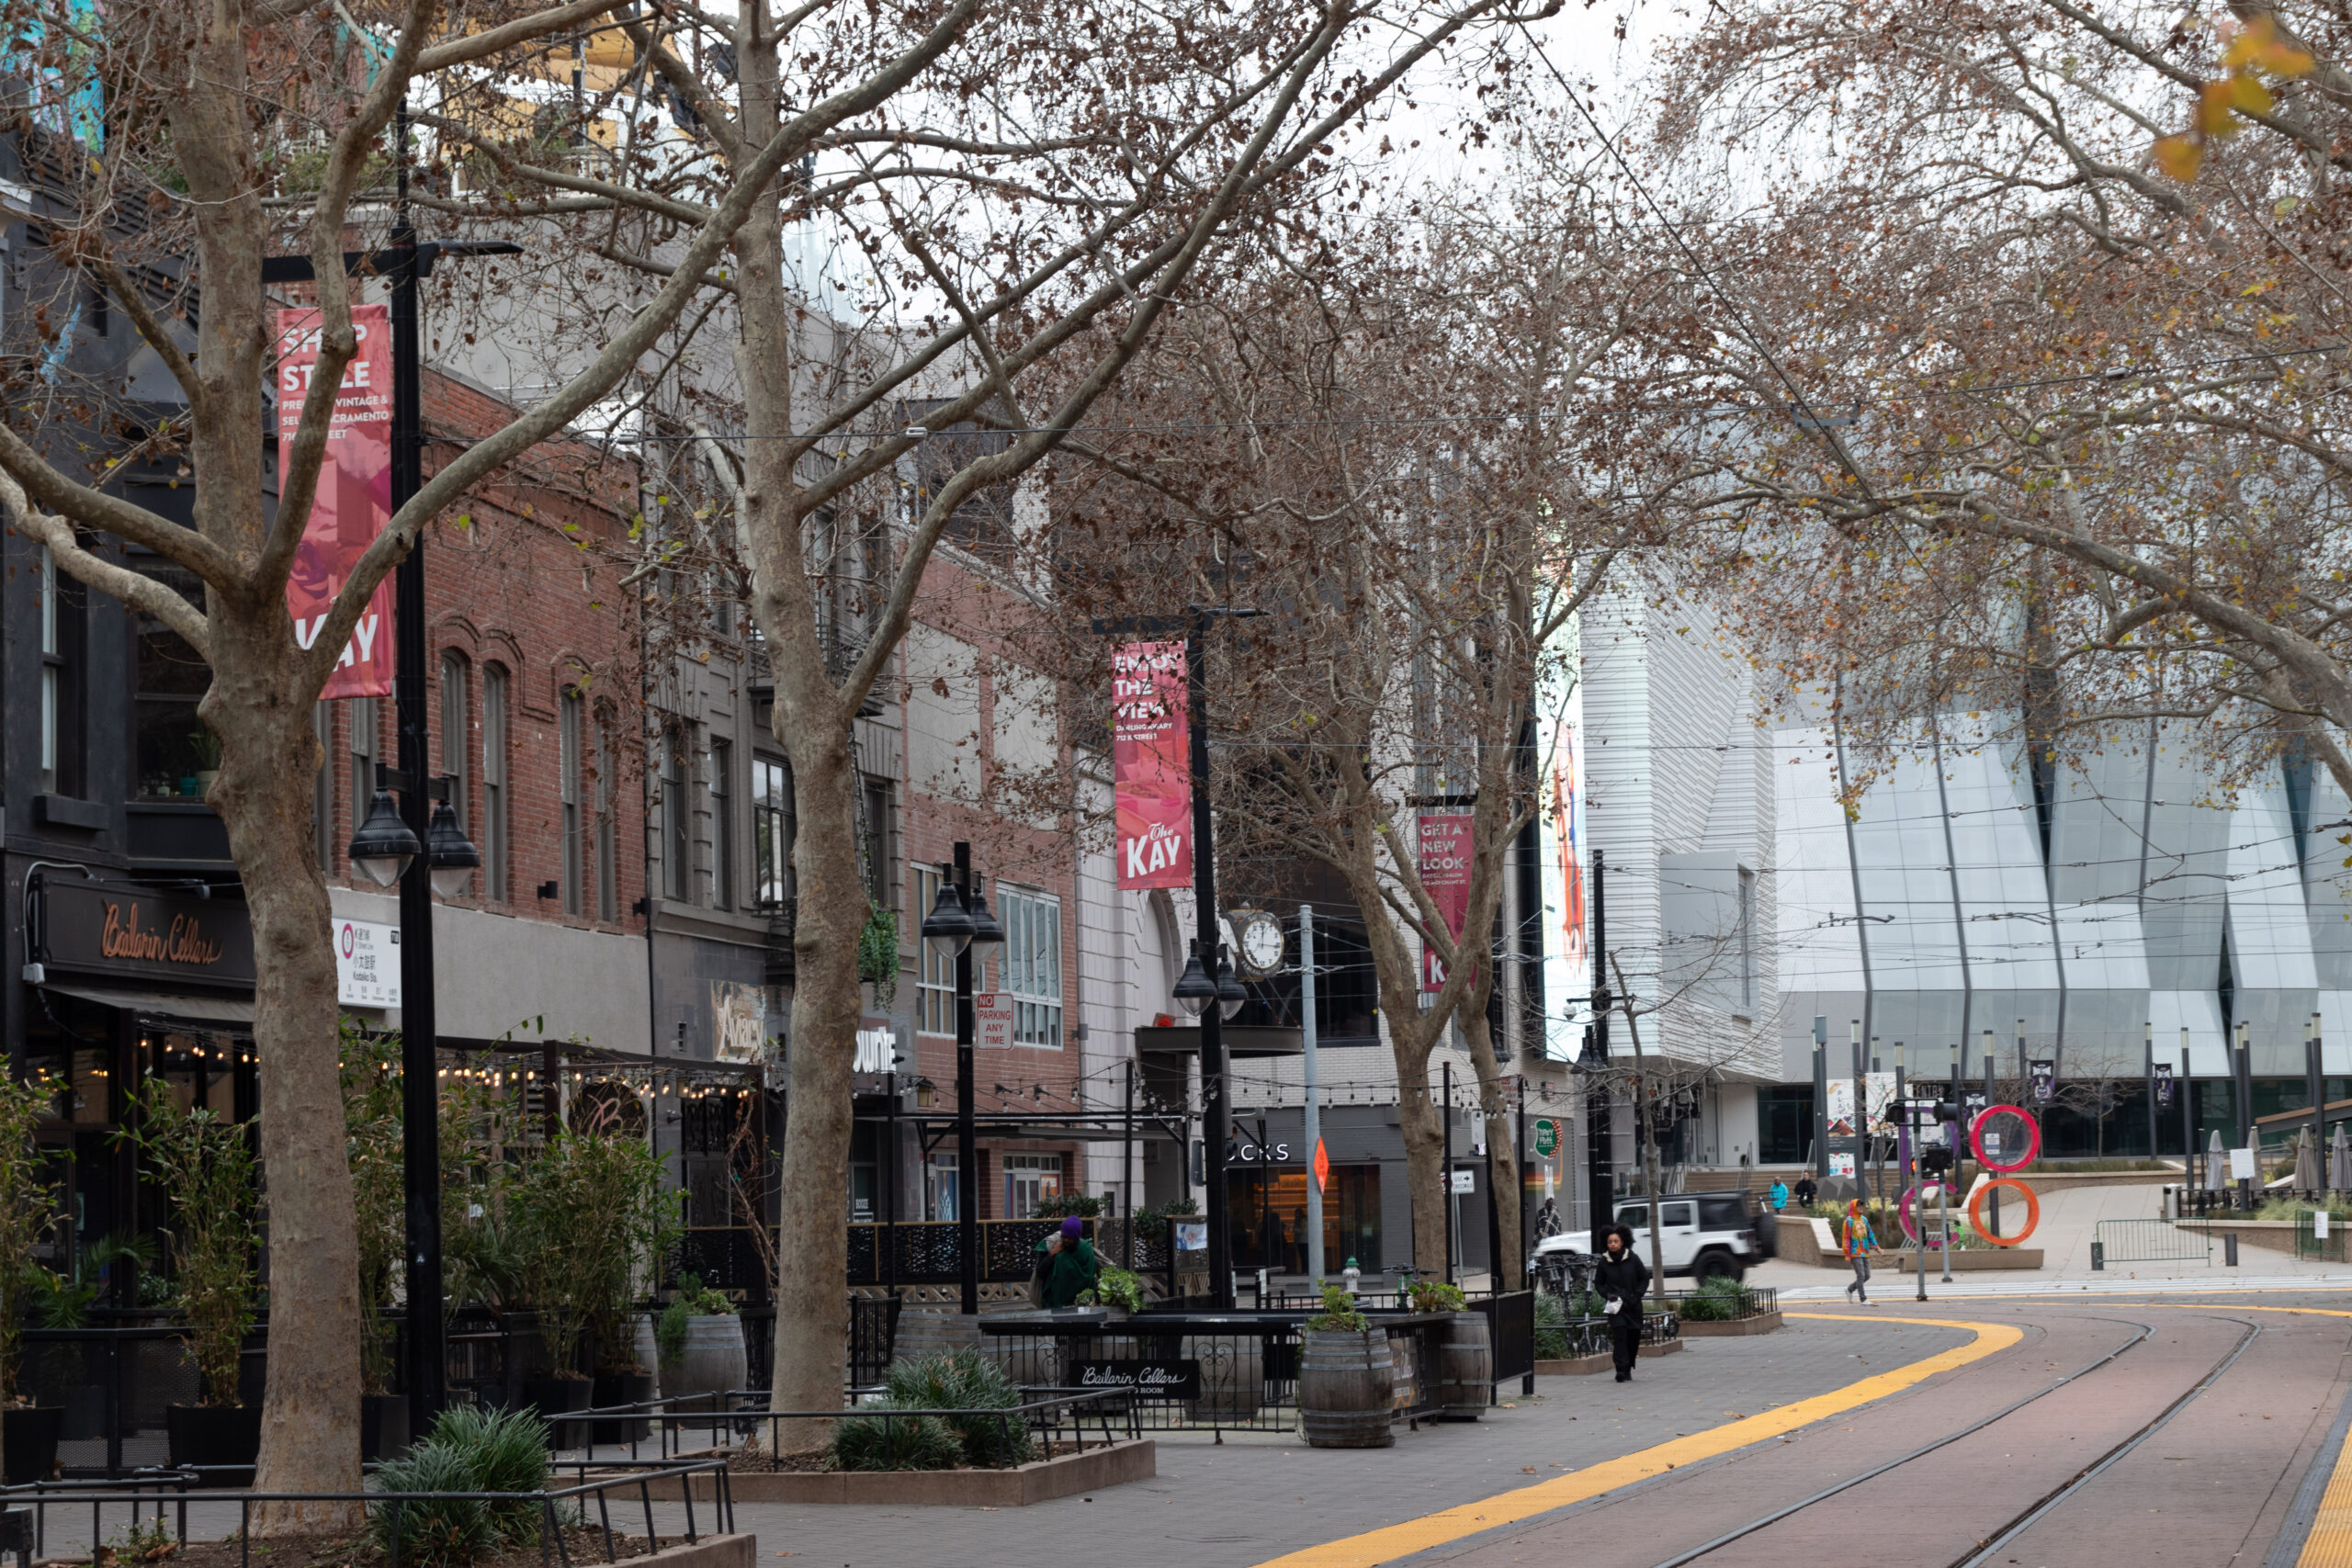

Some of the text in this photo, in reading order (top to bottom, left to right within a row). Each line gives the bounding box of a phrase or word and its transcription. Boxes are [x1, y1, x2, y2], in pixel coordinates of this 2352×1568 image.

[283, 323, 368, 354] SHP
[283, 362, 370, 391] STLE
[335, 395, 389, 408] VINTAGE &
[330, 411, 390, 423] CRAMENTO
[1114, 653, 1179, 672] ENJOY
[1114, 679, 1153, 696] THE
[1114, 701, 1167, 719] VIEW
[1148, 822, 1174, 840] The
[1421, 823, 1463, 836] GET A
[1422, 840, 1456, 852] NEW
[1127, 835, 1182, 878] KAY
[1422, 856, 1464, 870] LOOK
[169, 912, 223, 965] Cellars
[978, 996, 993, 1006] NO
[978, 1010, 1011, 1021] PARKING
[985, 1023, 1004, 1032] ANY
[984, 1035, 1005, 1044] TIME
[1228, 1144, 1289, 1161] CKS
[1082, 1365, 1187, 1384] Bailarin Cellars
